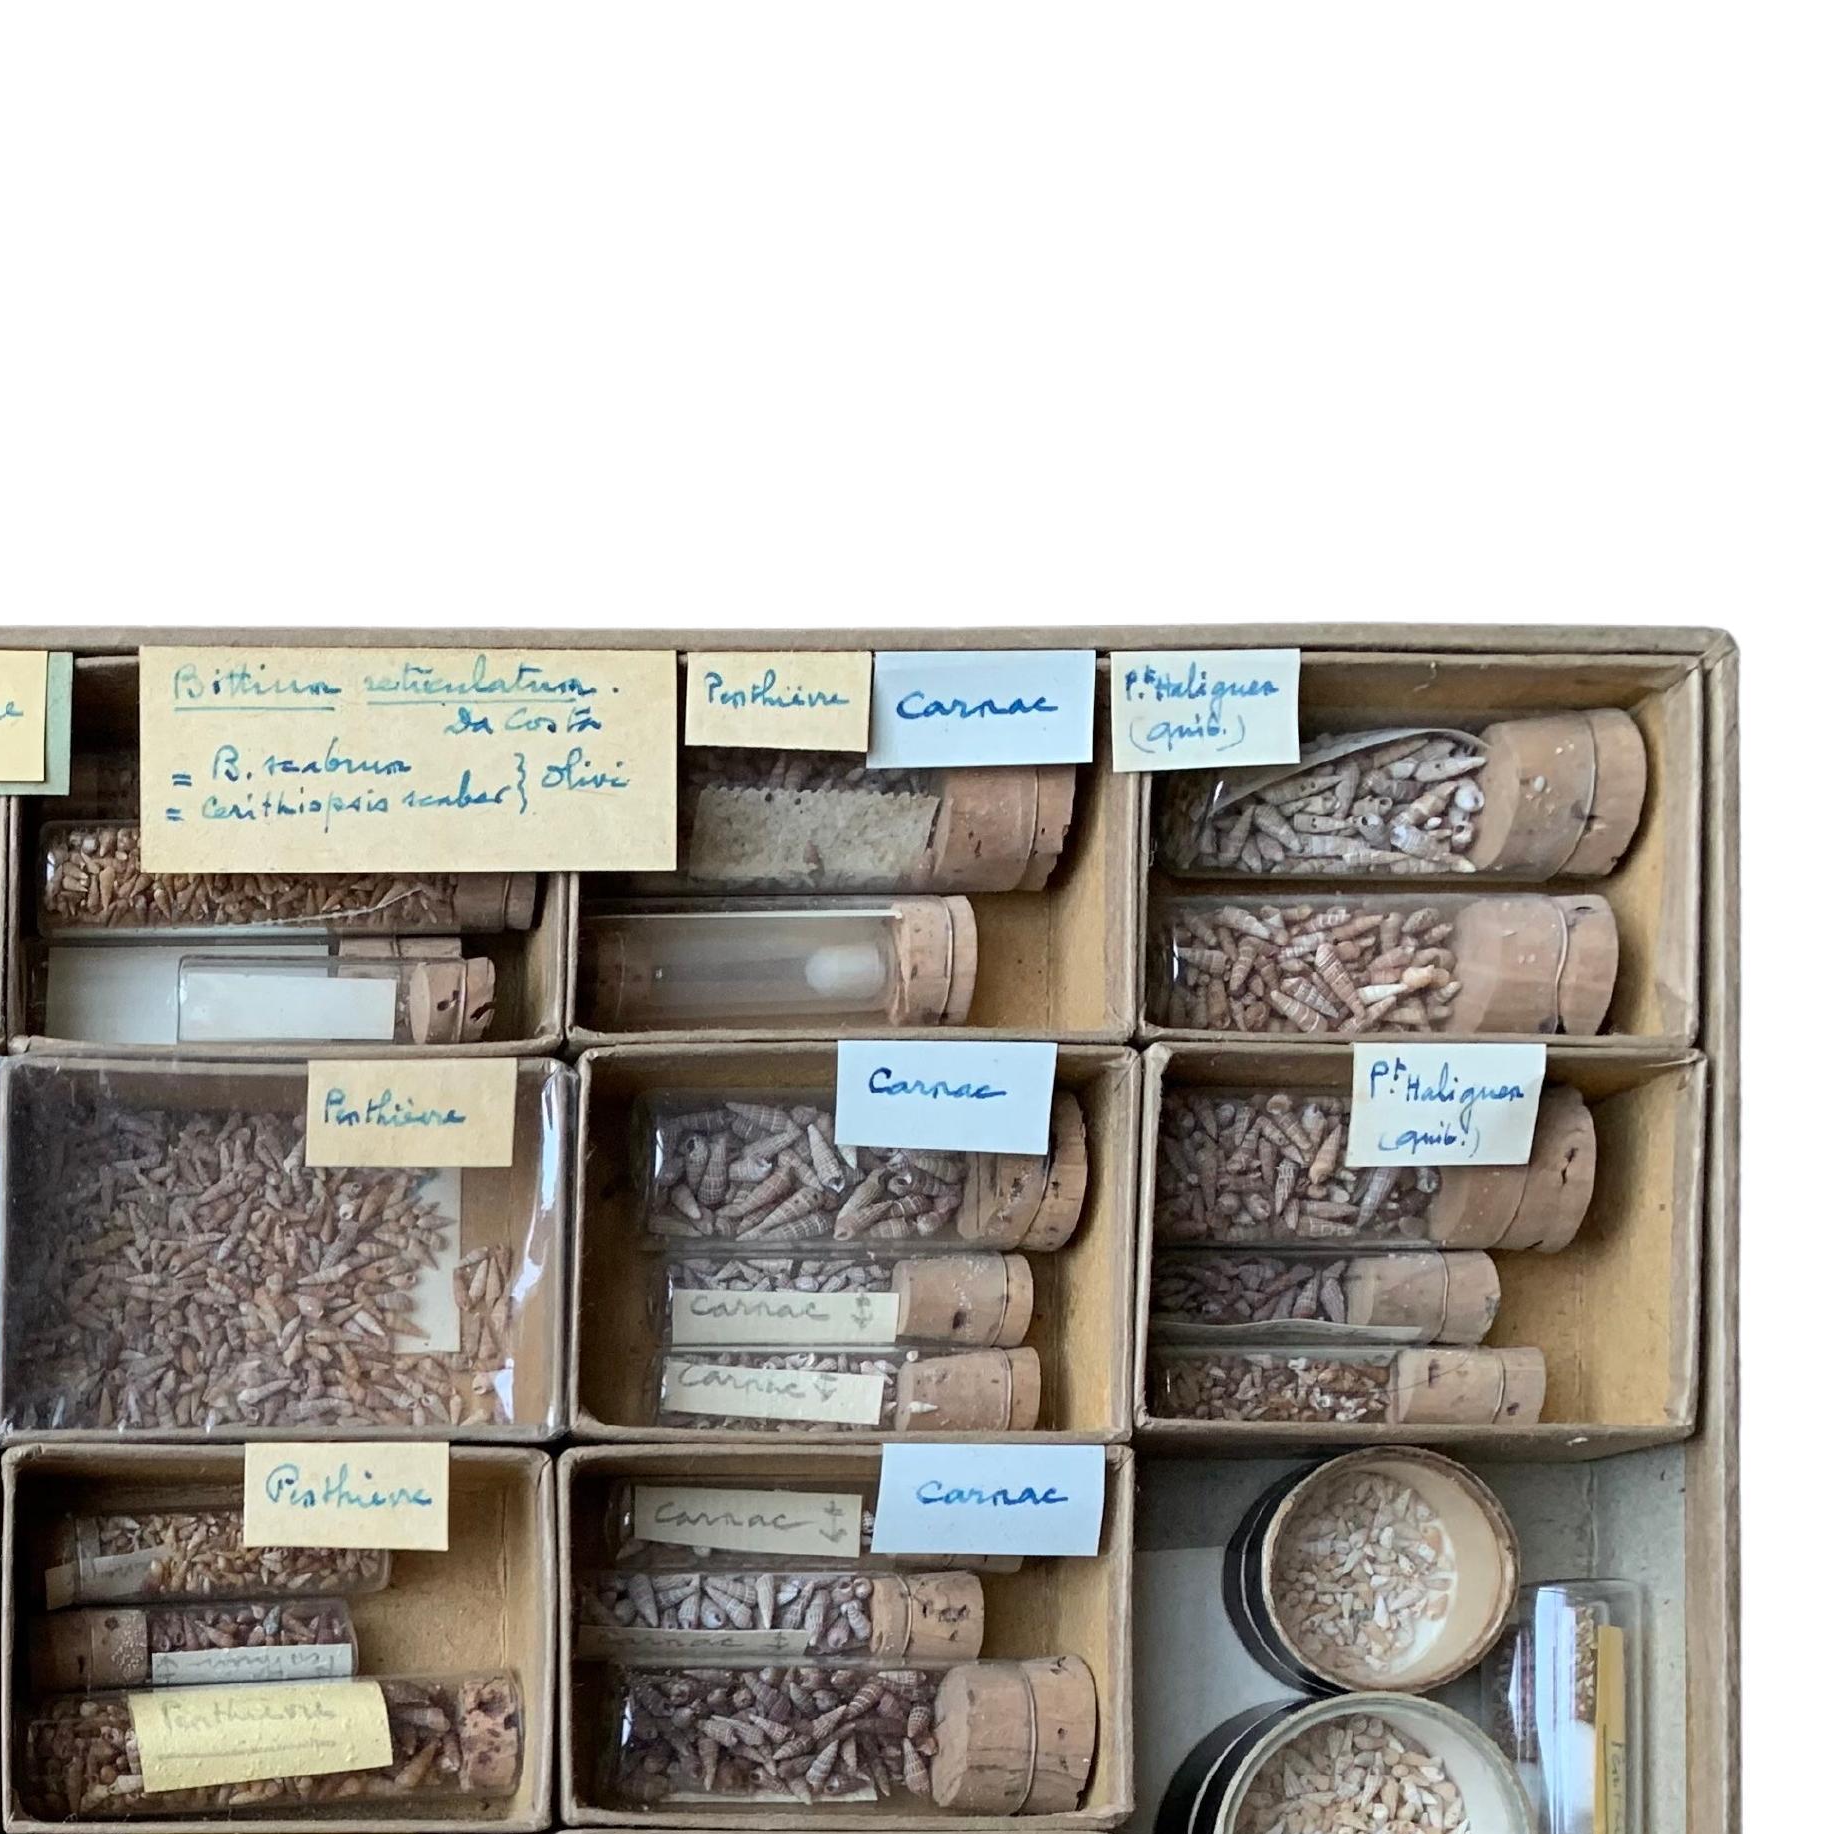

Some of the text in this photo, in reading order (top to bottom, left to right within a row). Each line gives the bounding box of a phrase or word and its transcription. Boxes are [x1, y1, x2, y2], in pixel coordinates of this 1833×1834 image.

[174, 665, 342, 697] Bittium
[896, 690, 1059, 721] Carnac
[868, 1066, 1008, 1100] Carnac
[689, 1294, 832, 1323] Carnac
[677, 1363, 807, 1398] Carnac
[915, 1479, 1070, 1508] Carnac
[655, 1499, 816, 1532] Carnac
